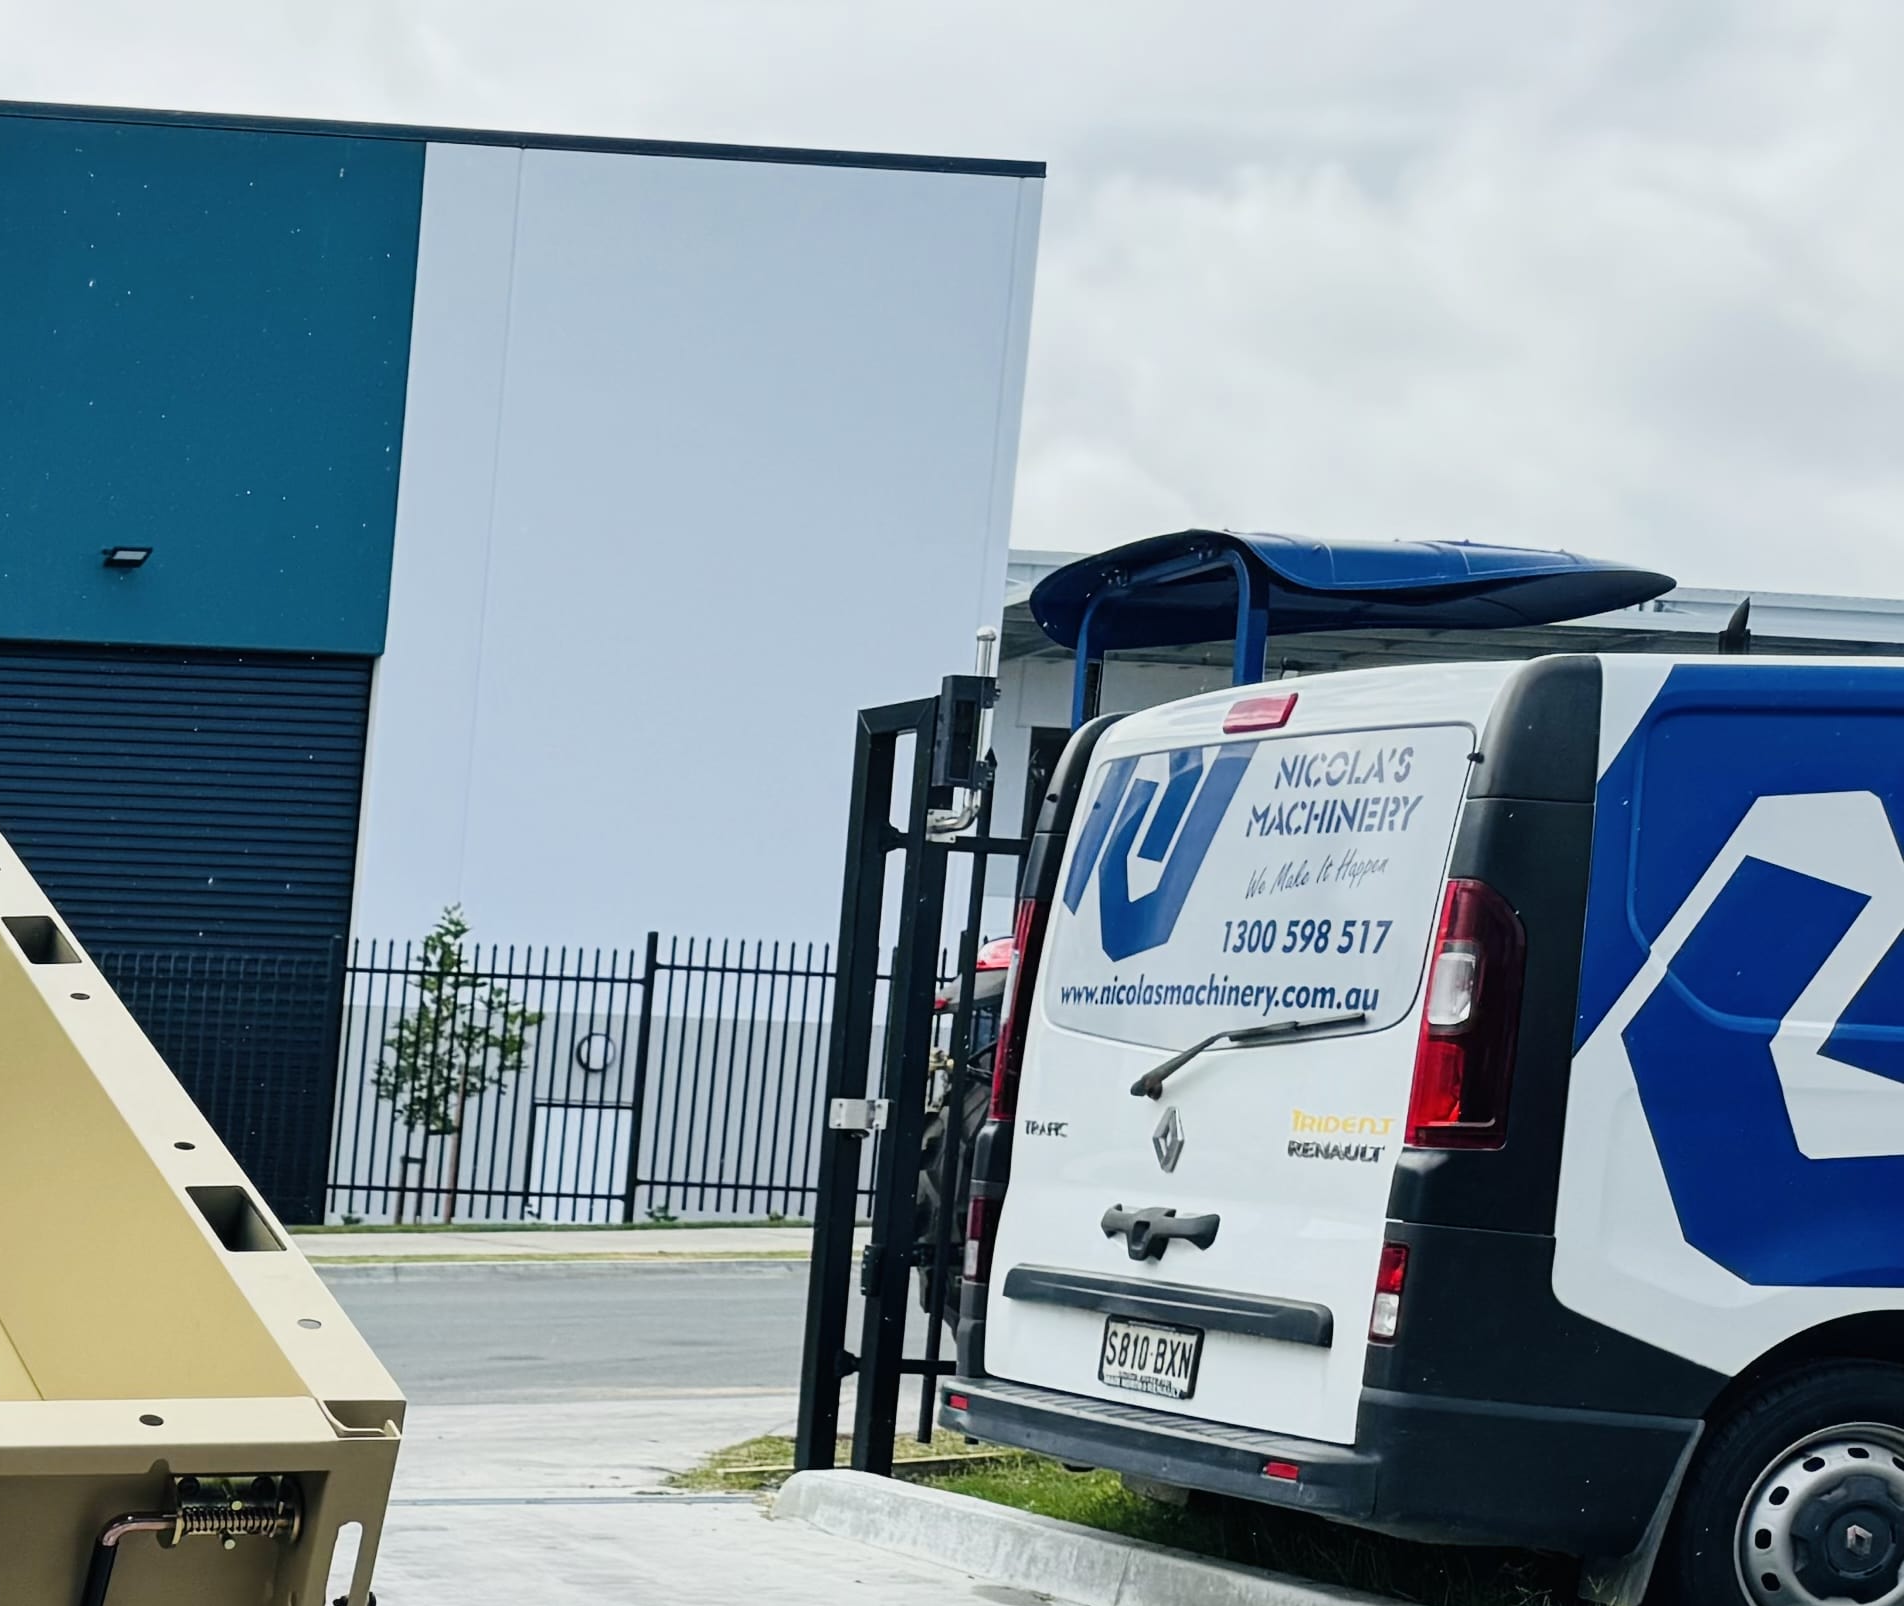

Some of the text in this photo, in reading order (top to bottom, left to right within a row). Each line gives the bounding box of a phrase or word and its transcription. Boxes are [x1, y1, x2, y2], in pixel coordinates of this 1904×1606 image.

[1274, 747, 1414, 790] NICOLA'S
[1246, 795, 1424, 838] MACHINERY
[1245, 847, 1389, 900] We Make It Happen
[1222, 919, 1393, 954] 1300 598 517
[1060, 973, 1379, 1017] www.nicolasmachinery.com.au
[1292, 1109, 1396, 1135] TRIDENT
[1287, 1140, 1386, 1163] RENAULT
